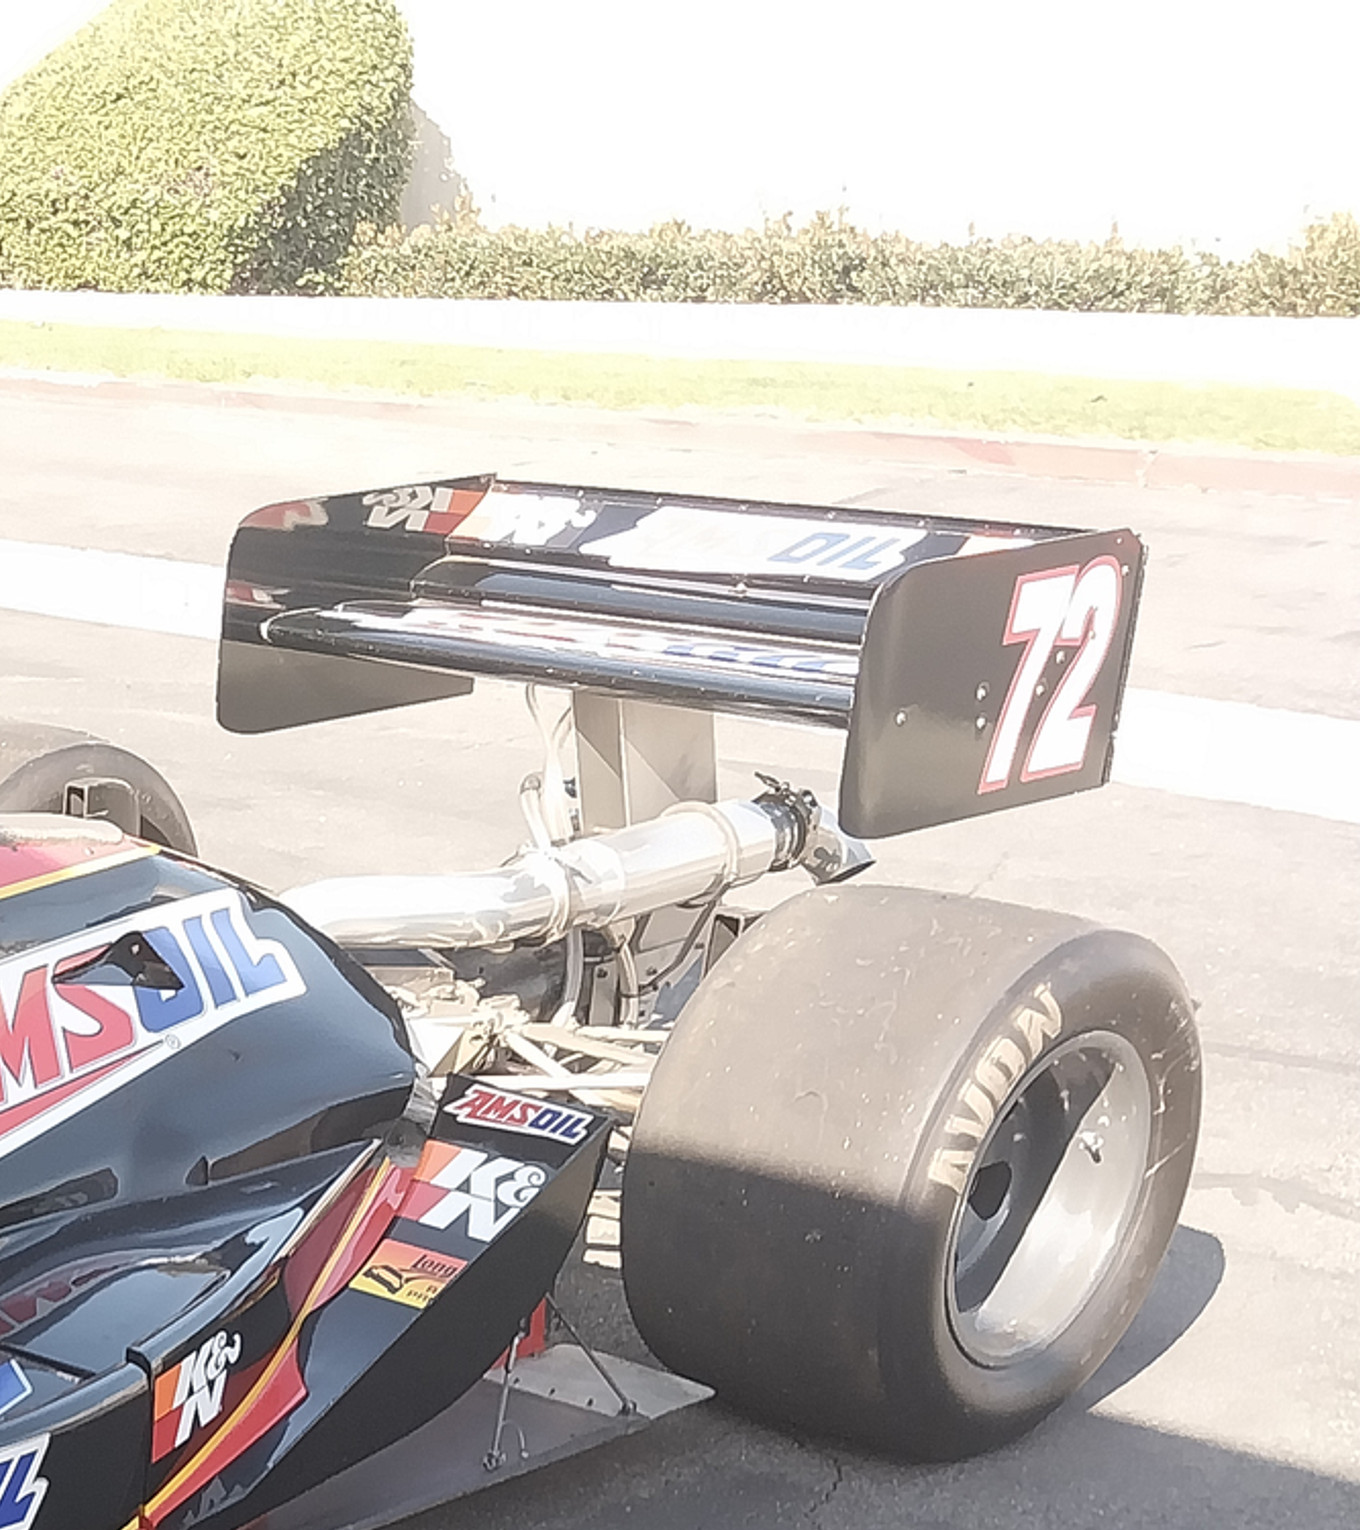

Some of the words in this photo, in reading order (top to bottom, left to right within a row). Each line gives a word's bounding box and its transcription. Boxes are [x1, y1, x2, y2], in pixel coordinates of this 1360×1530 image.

[977, 554, 1122, 796] 72
[453, 1088, 586, 1140] AMSOIL
[928, 982, 1063, 1196] AVON
[171, 1329, 242, 1449] K&N
